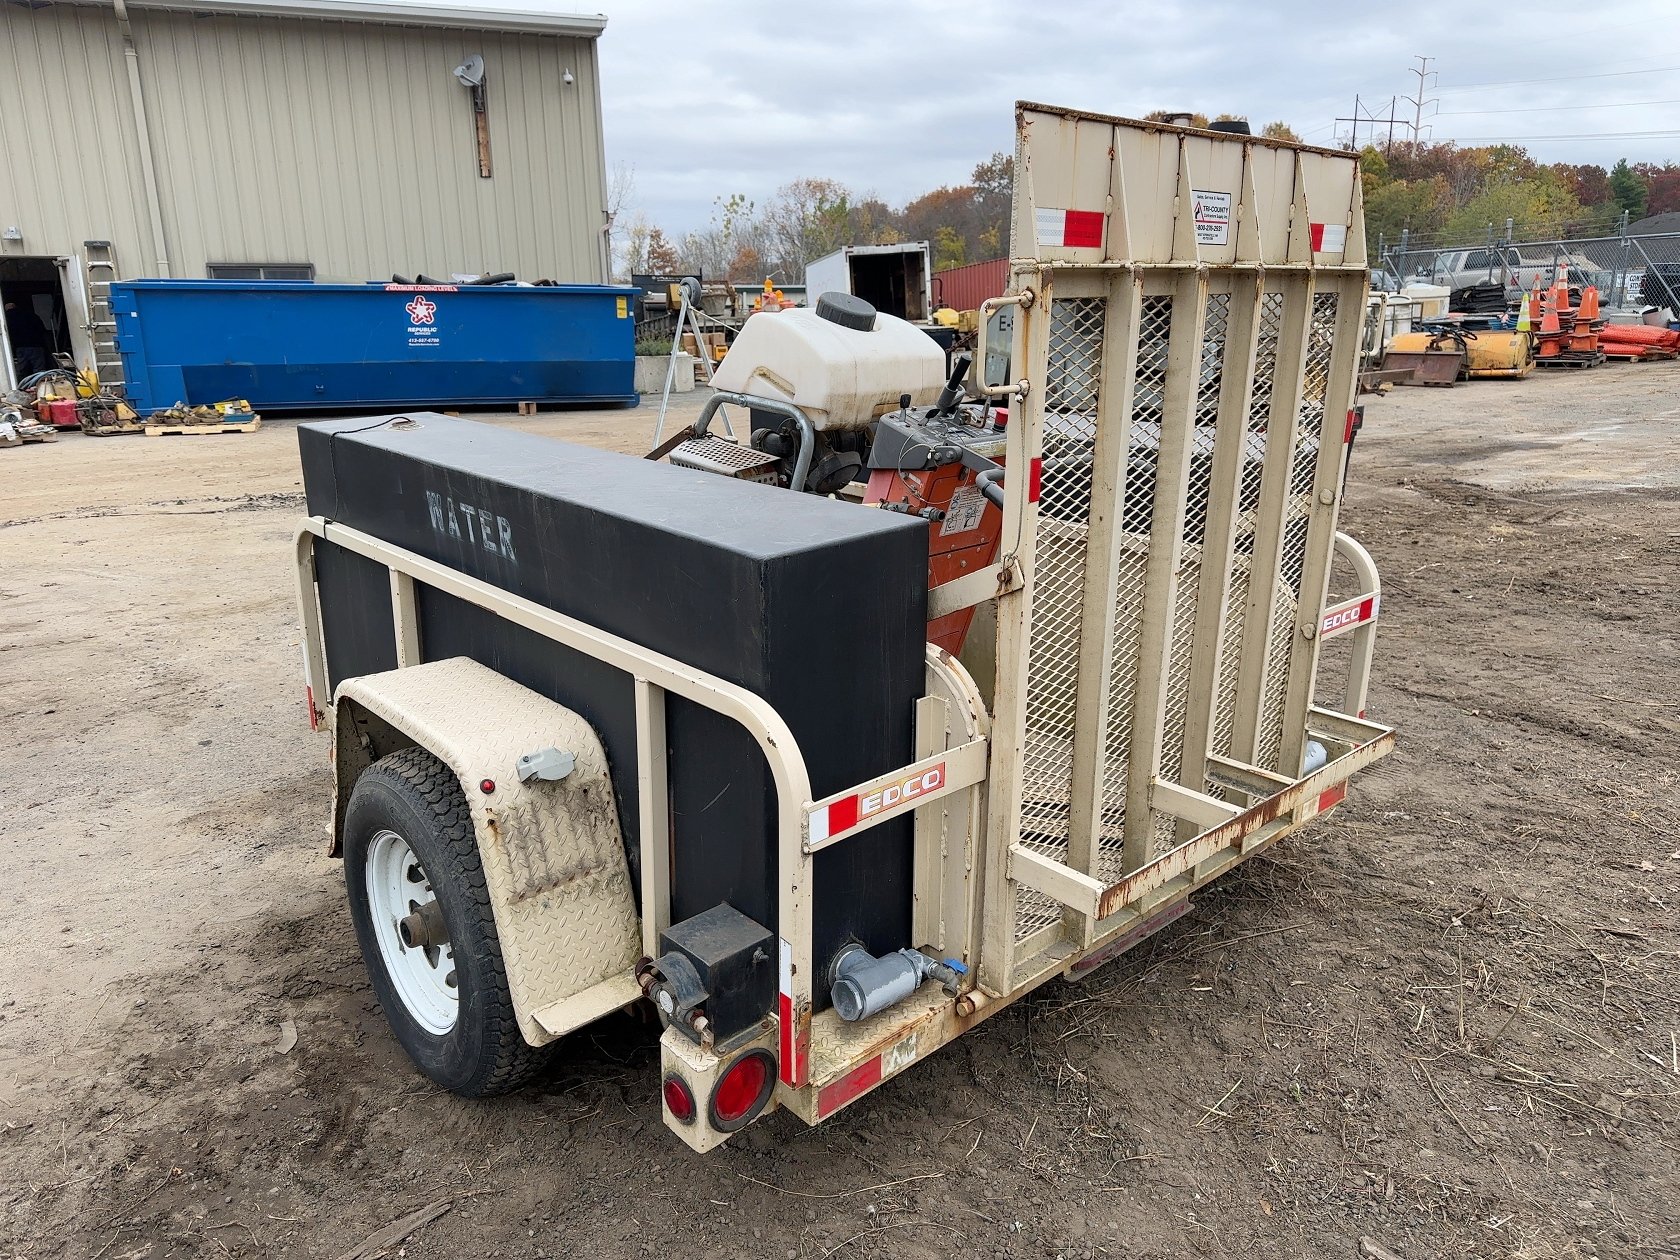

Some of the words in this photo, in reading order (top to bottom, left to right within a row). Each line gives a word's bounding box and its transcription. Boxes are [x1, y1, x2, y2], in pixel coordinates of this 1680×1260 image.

[426, 490, 516, 560] WATER
[1322, 607, 1360, 631] EDCO
[861, 769, 940, 816] EDCO
